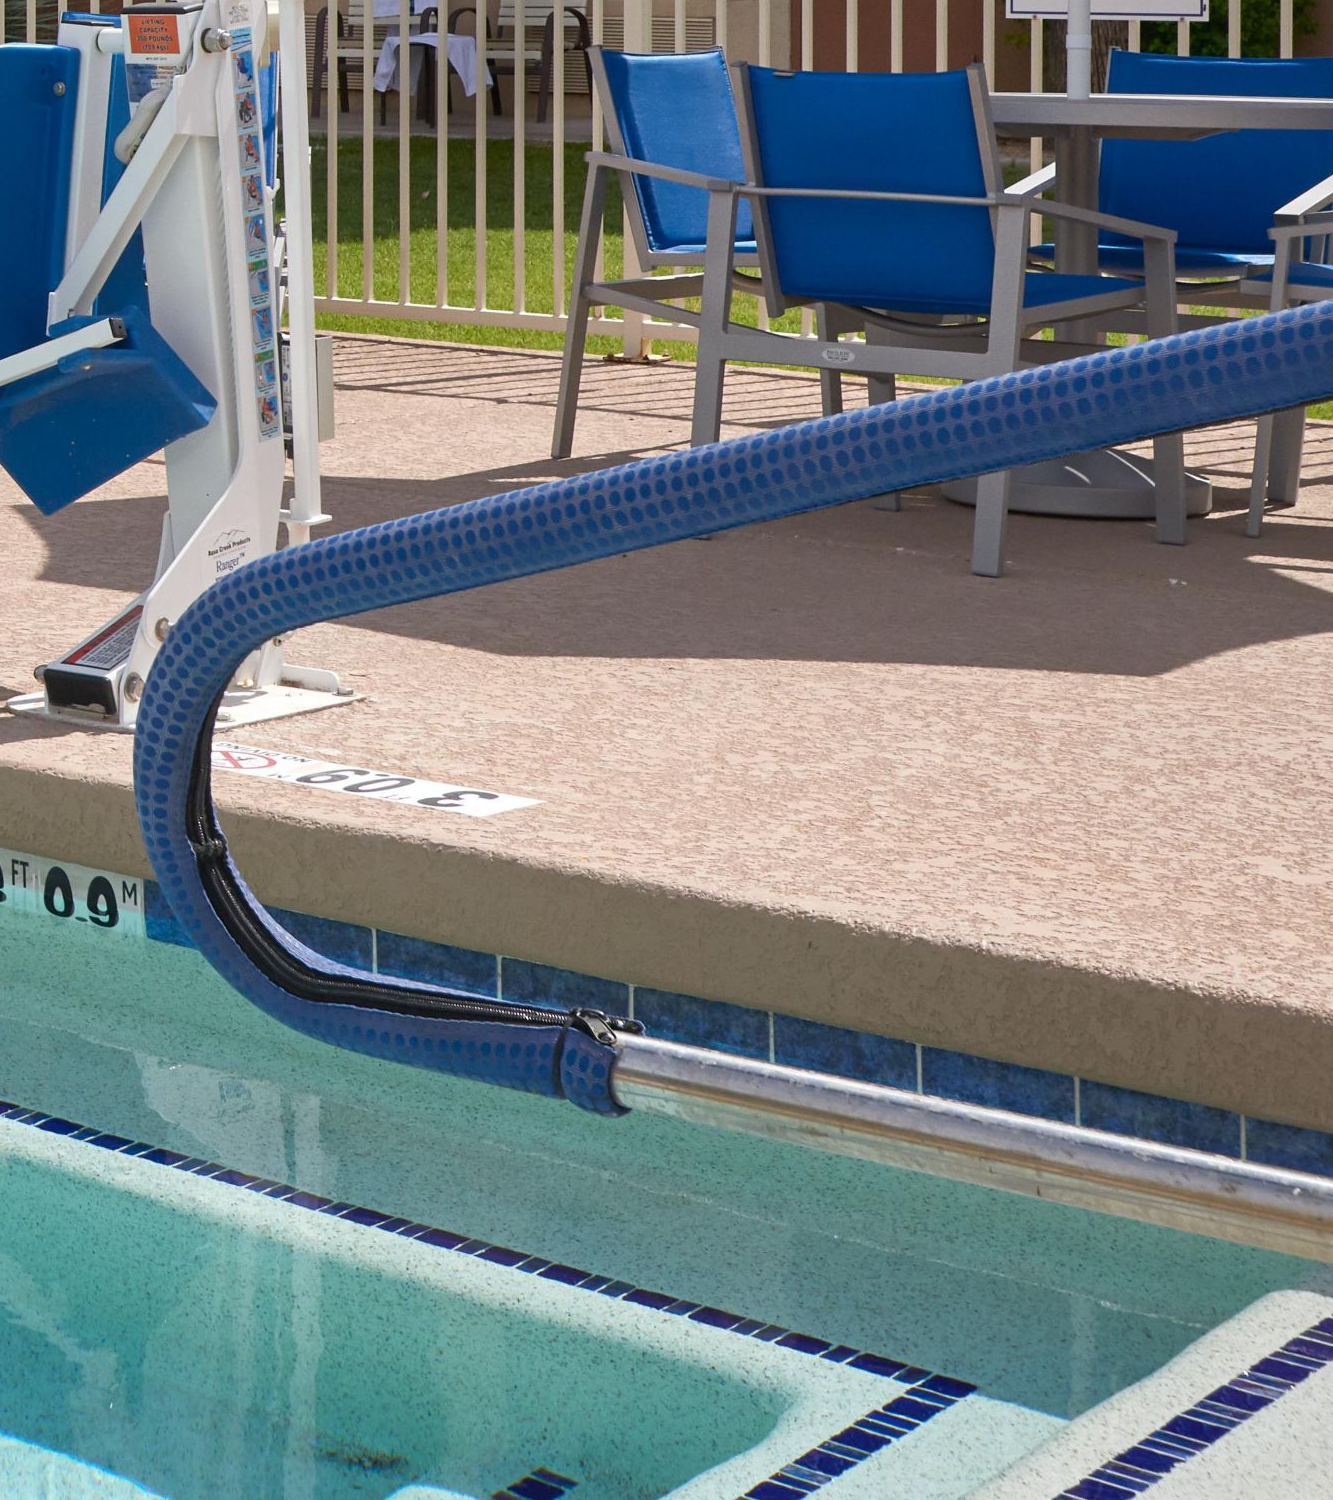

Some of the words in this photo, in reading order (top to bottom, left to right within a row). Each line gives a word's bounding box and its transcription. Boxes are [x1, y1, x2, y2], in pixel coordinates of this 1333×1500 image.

[417, 790, 499, 808] 3
[11, 859, 30, 889] FT
[122, 880, 138, 906] M
